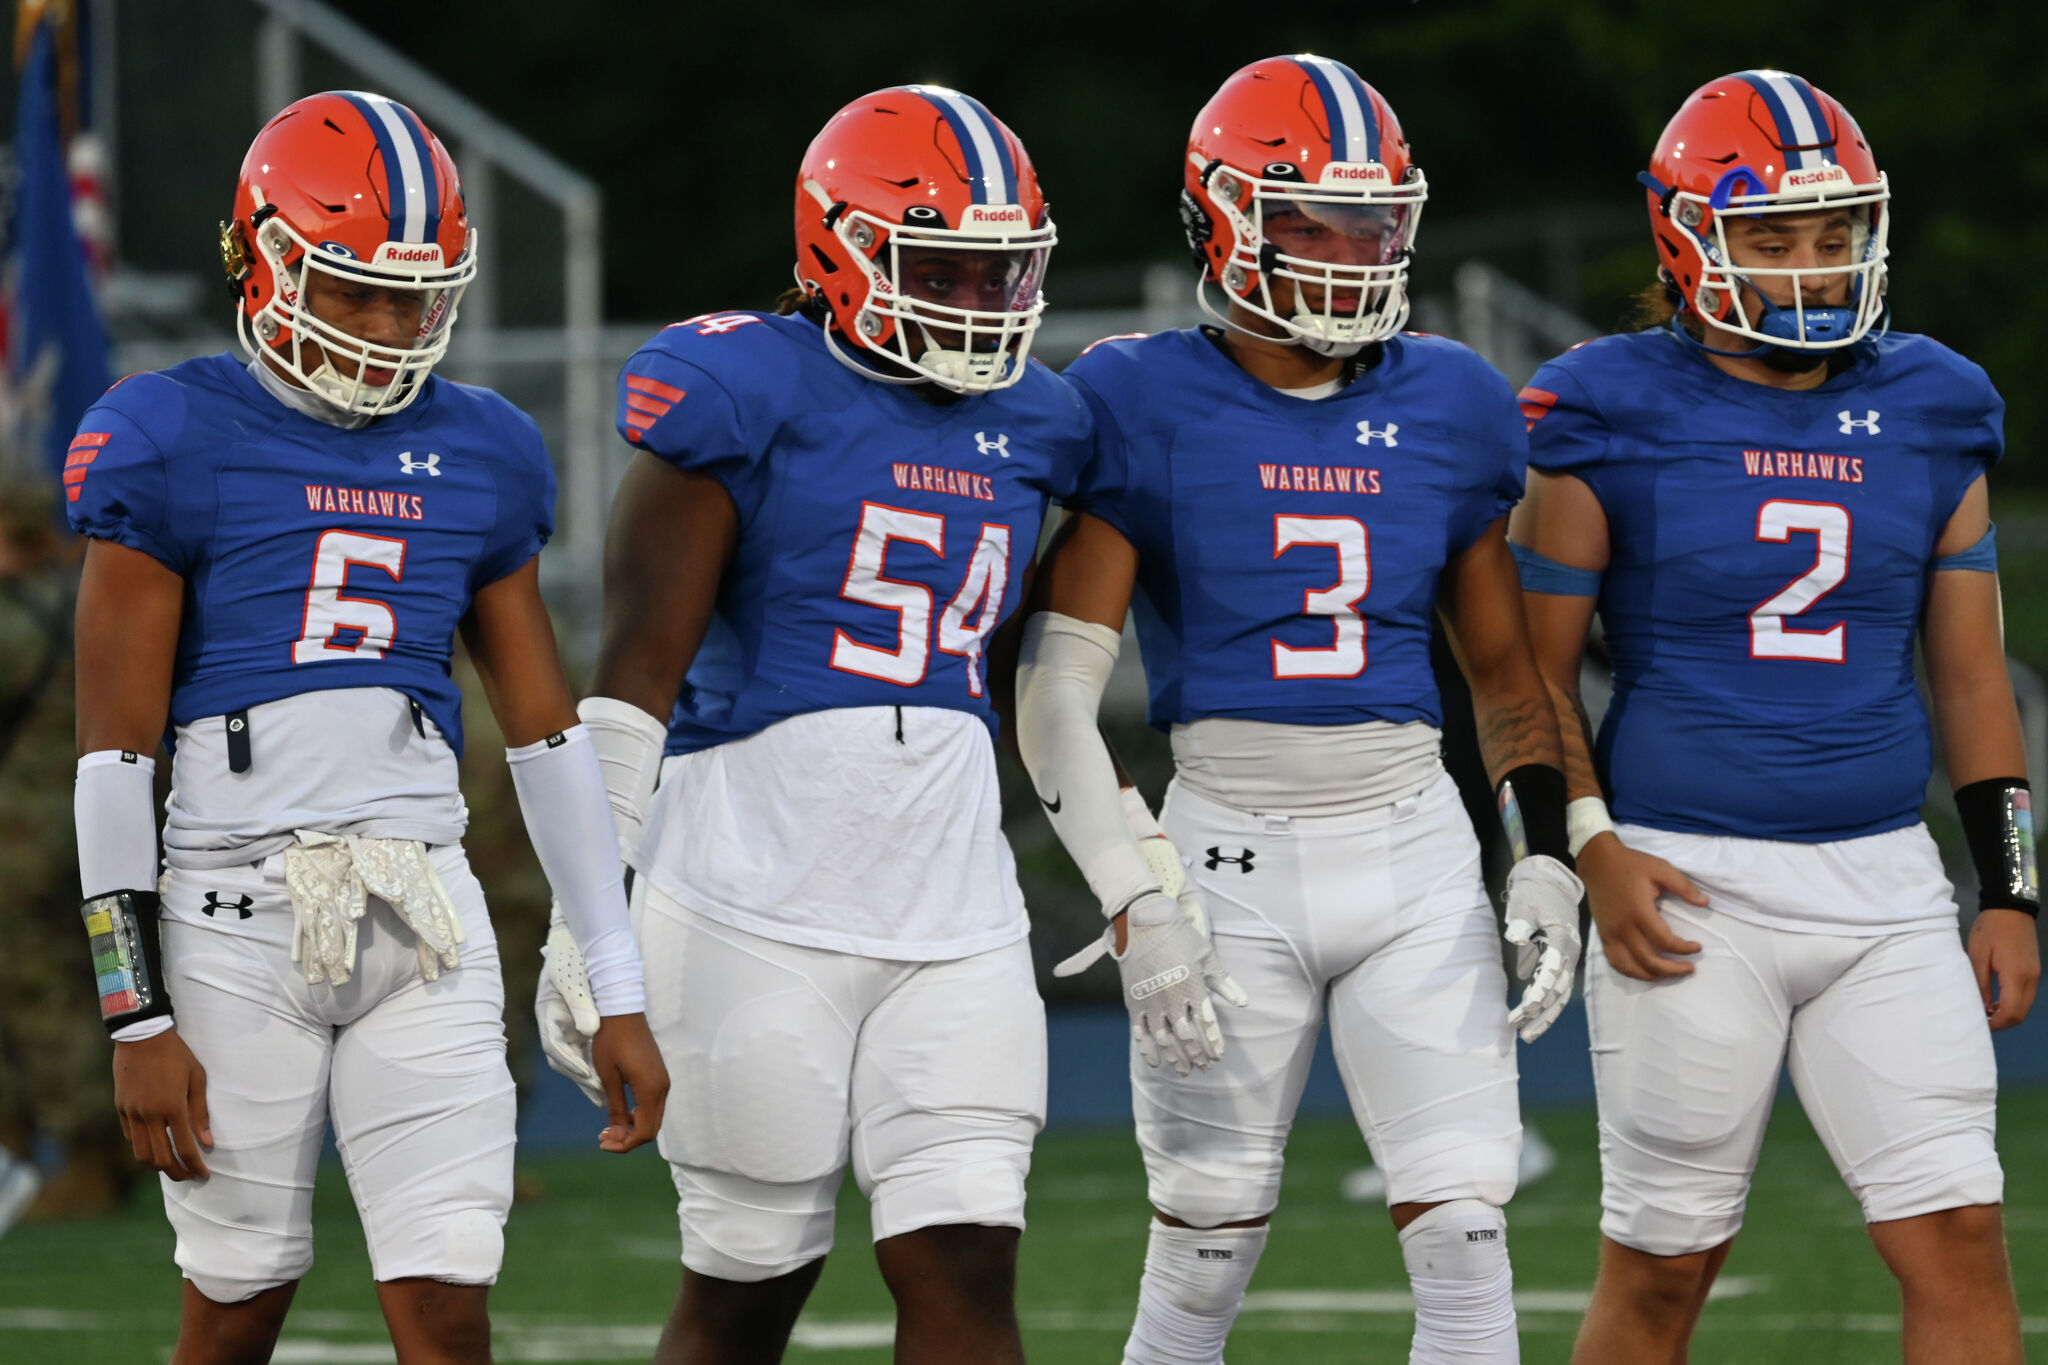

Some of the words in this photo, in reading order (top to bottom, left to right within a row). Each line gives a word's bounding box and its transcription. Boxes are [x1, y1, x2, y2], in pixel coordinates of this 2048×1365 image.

[1332, 167, 1385, 180] Riddell
[972, 209, 1023, 222] Riddell
[386, 247, 439, 262] Riddell
[415, 293, 448, 339] Riddell
[891, 462, 995, 502] WARHAWKS
[1258, 463, 1382, 495] WARHAWKS
[1742, 449, 1864, 484] WARHAWKS
[304, 484, 424, 521] WARHAWKS
[290, 528, 407, 665] 6
[828, 499, 1011, 698] 54
[1270, 512, 1372, 680] 3
[1747, 497, 1853, 665] 2
